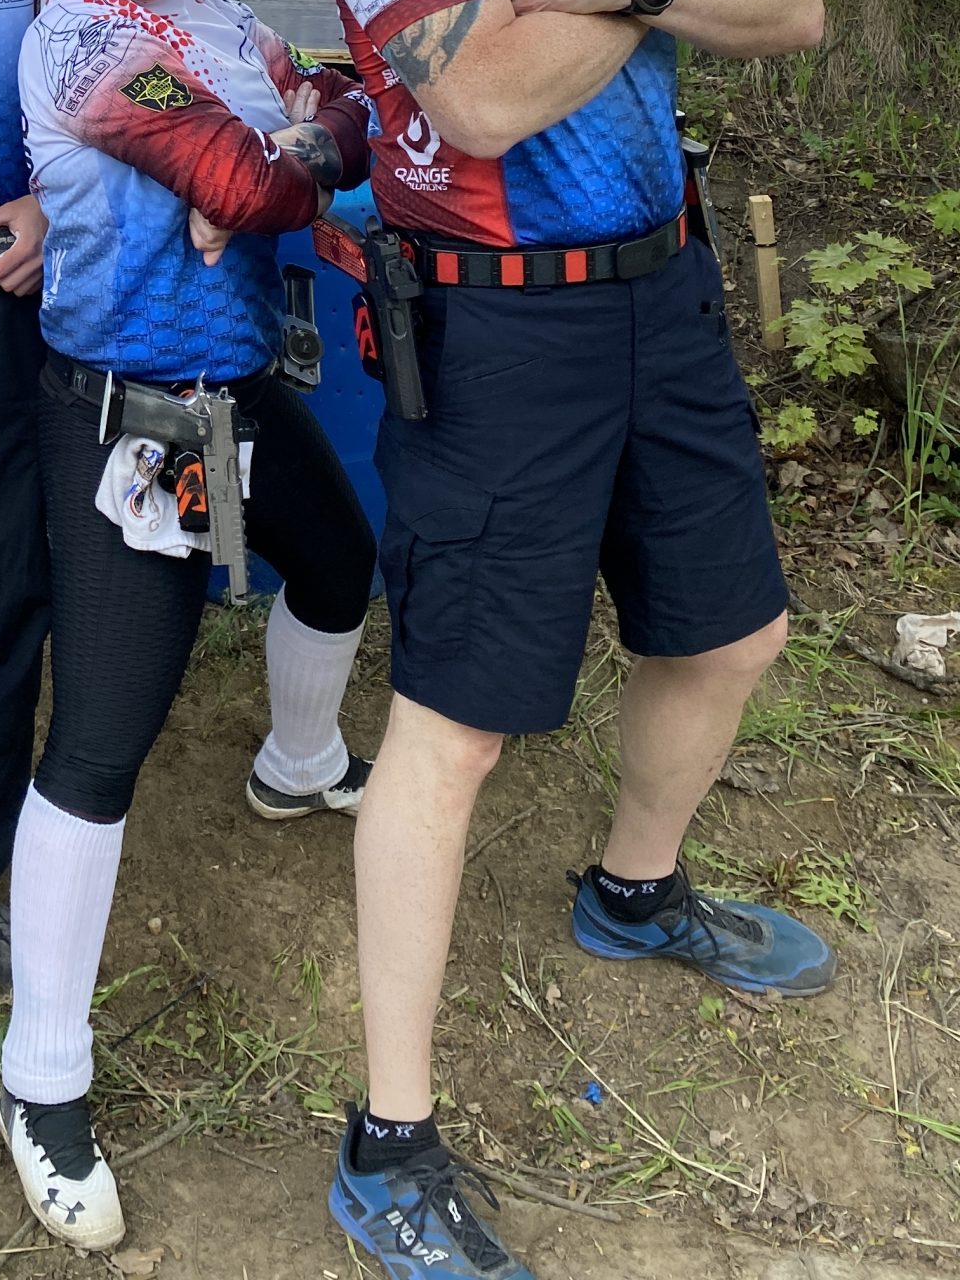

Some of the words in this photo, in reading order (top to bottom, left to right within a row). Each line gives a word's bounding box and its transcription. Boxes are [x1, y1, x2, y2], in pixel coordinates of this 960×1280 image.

[65, 60, 110, 112] SHIELD
[395, 168, 452, 183] RANGE
[403, 181, 448, 191] OLUTIONS
